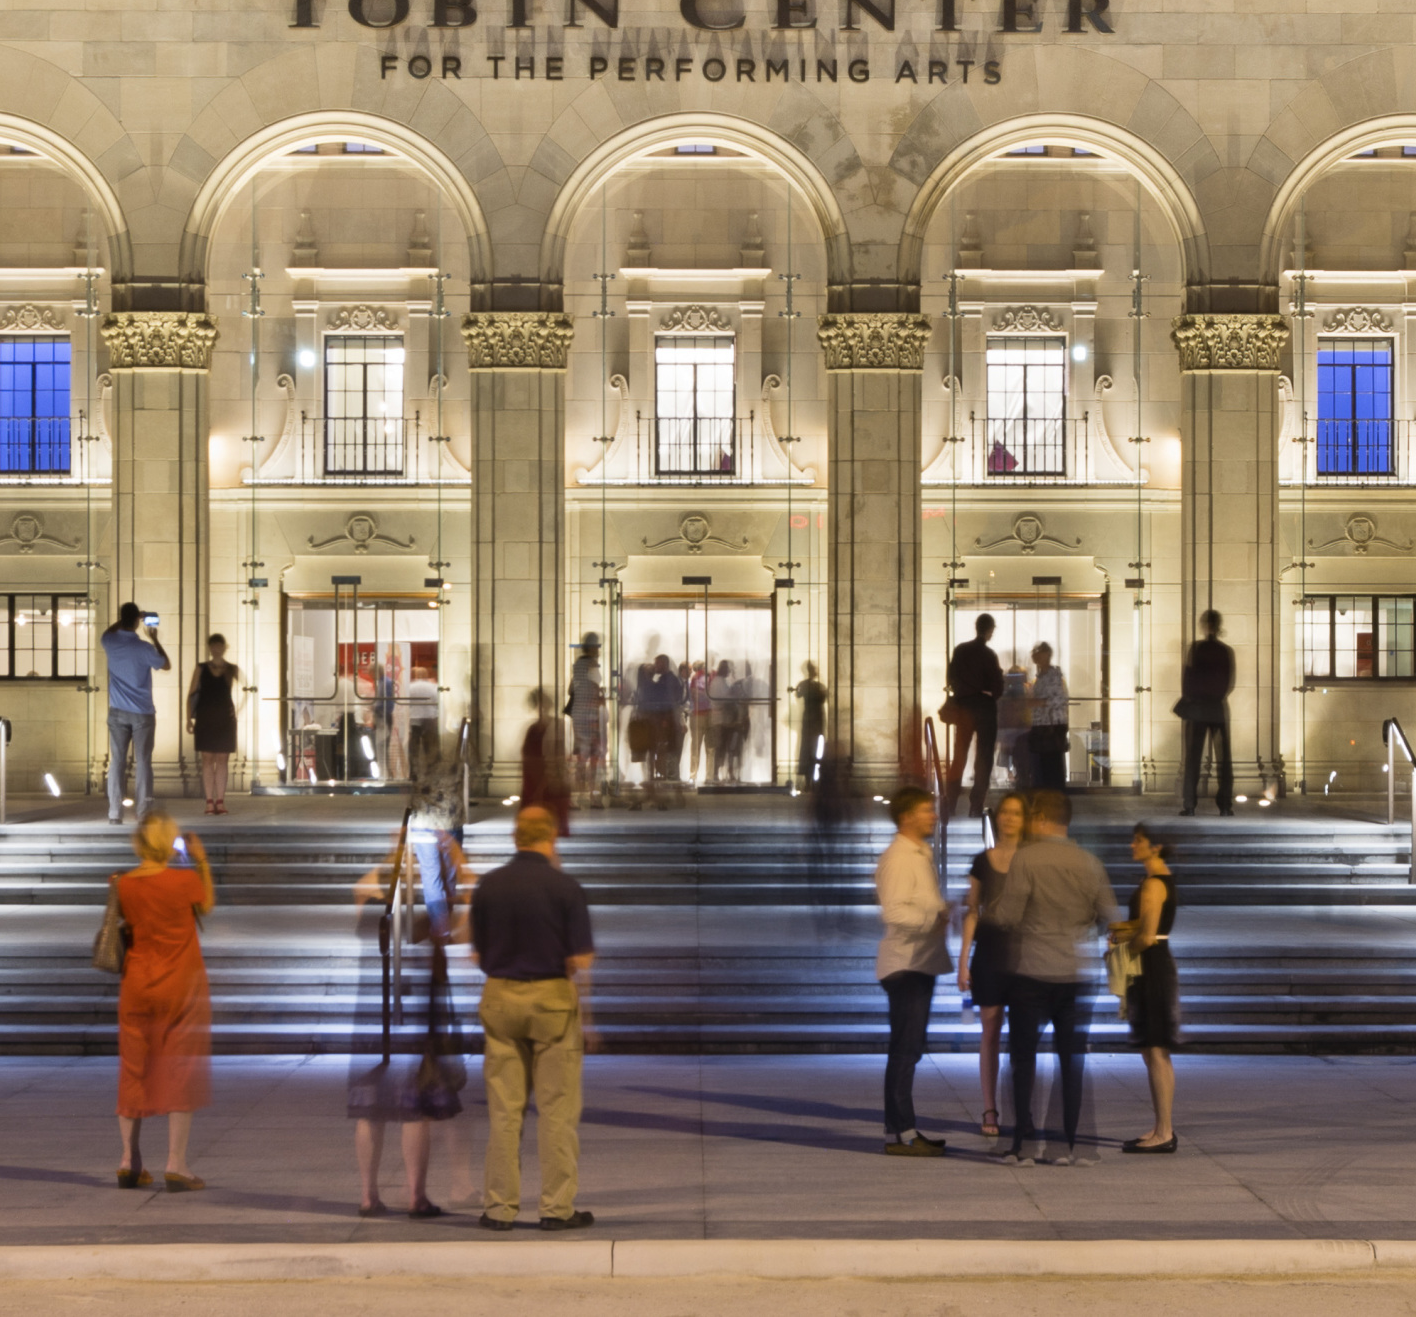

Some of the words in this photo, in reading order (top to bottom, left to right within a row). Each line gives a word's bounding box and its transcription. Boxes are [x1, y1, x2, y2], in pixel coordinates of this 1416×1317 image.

[382, 55, 462, 80] FOR
[487, 55, 565, 81] THE
[590, 56, 870, 82] PERFORMING
[894, 59, 1003, 84] ARTS
